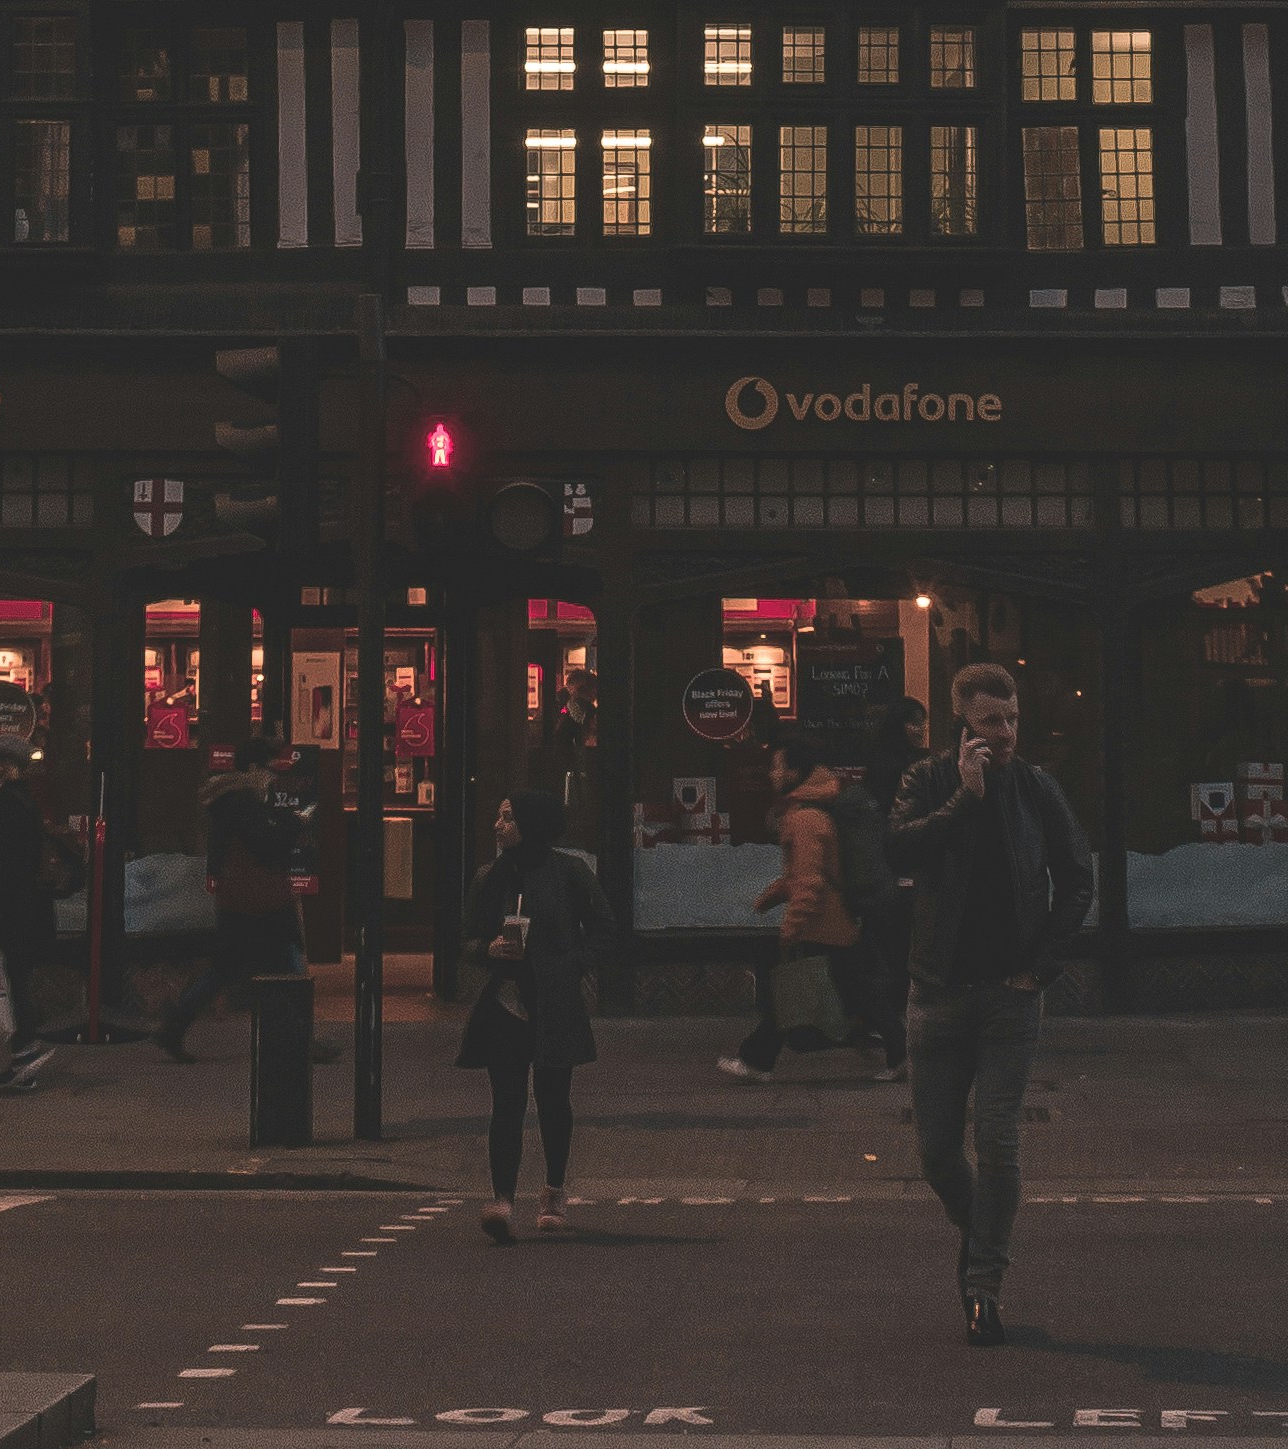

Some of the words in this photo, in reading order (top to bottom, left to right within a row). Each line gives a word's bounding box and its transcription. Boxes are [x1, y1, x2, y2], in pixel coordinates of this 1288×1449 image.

[785, 383, 1003, 422] vodafone
[691, 689, 715, 700] Black
[717, 689, 744, 699] Friday
[0, 702, 28, 713] Friday
[326, 1406, 714, 1427] LOOK
